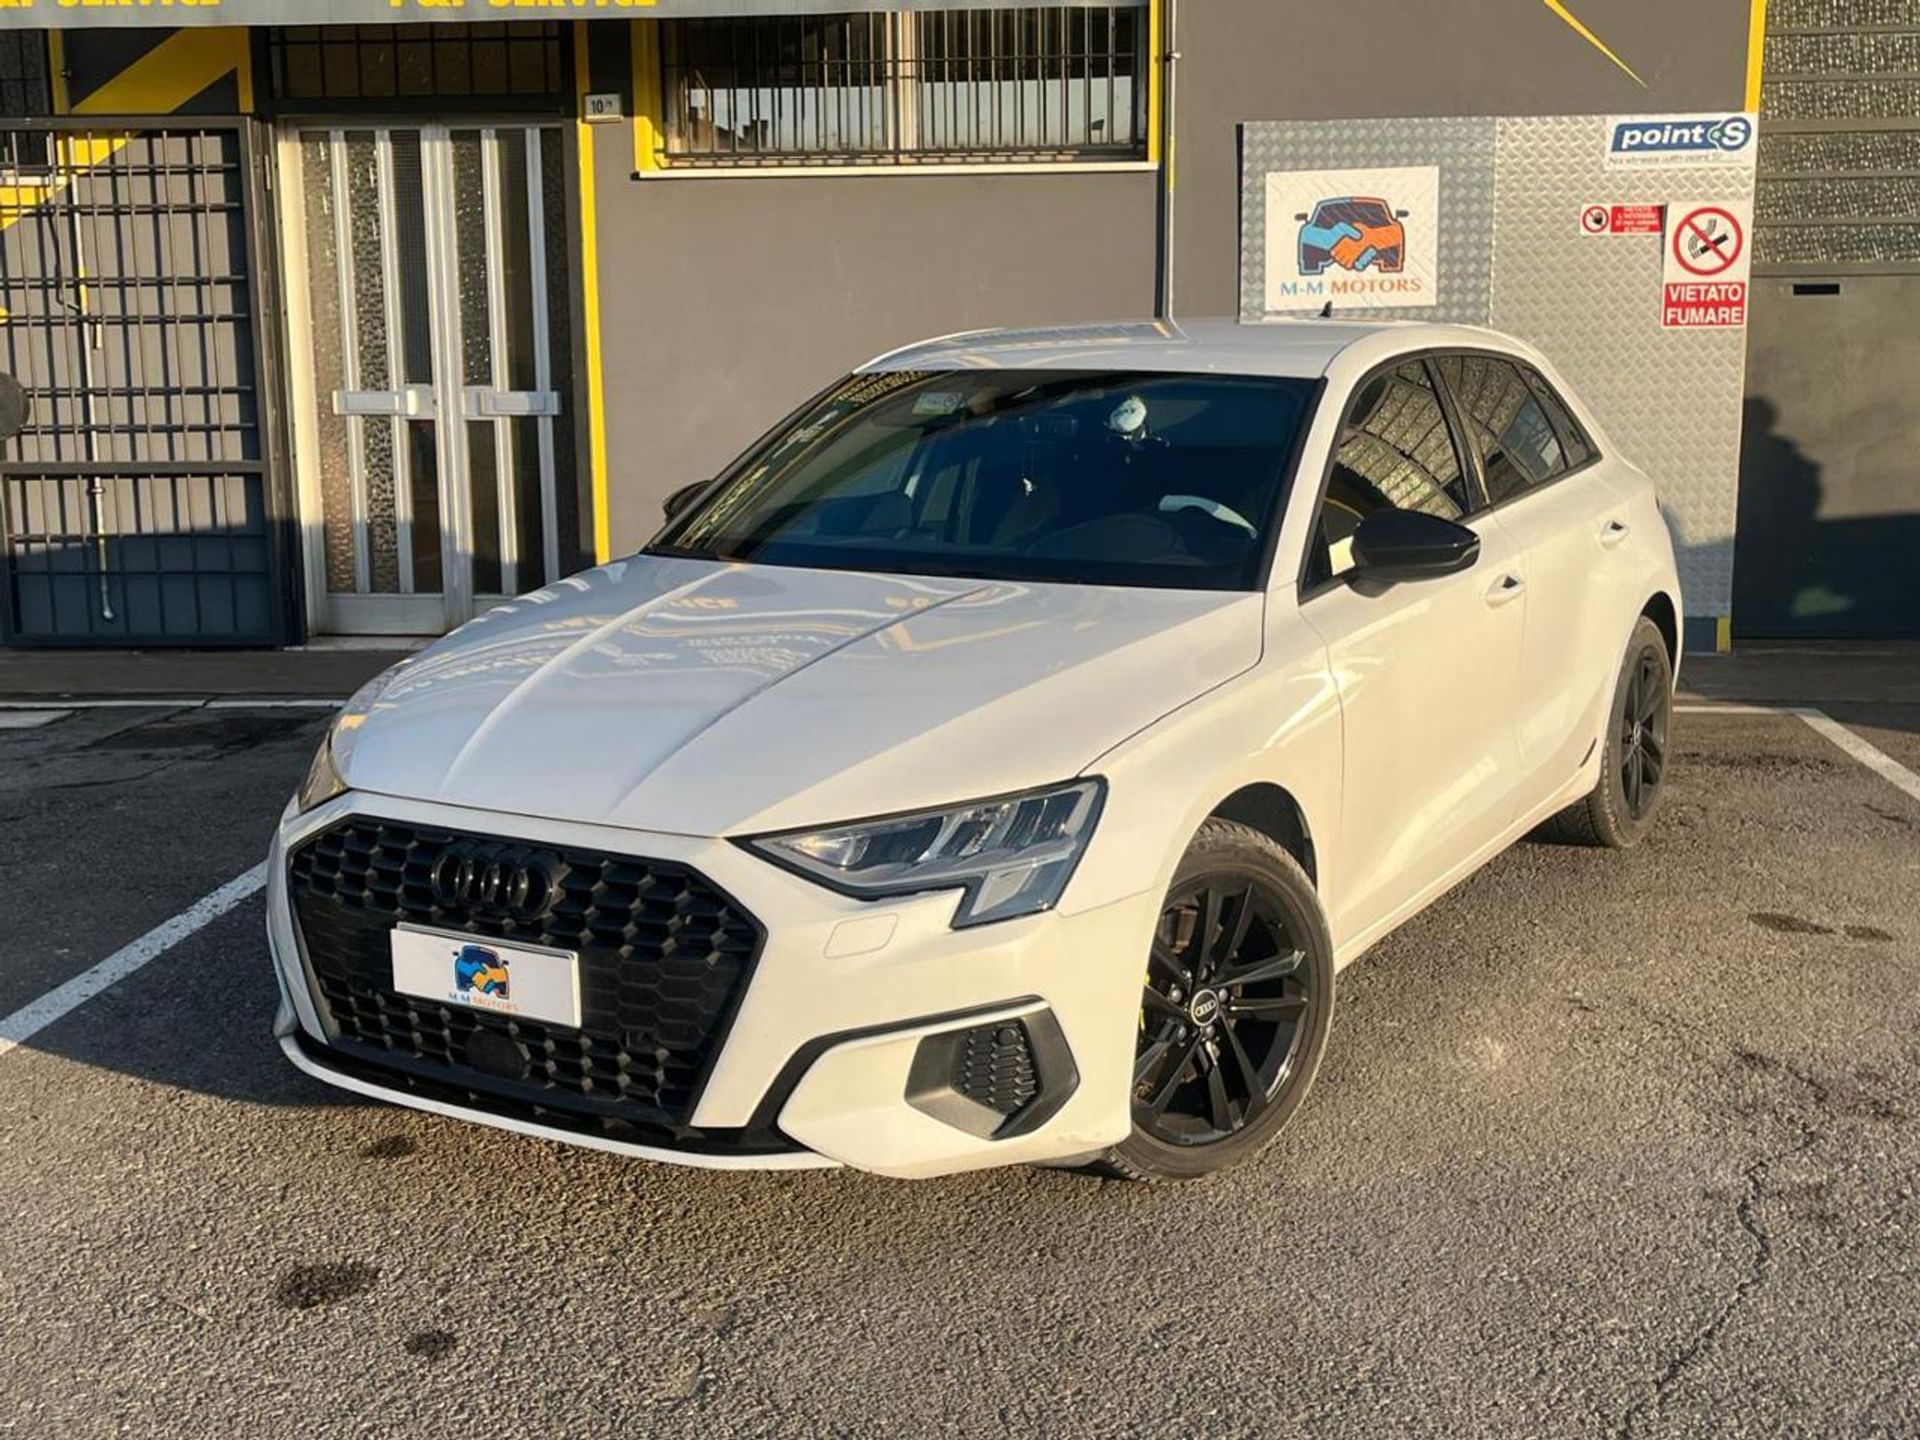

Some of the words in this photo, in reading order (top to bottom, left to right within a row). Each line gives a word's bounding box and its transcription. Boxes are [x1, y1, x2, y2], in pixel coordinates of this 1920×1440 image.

[1621, 124, 1705, 149] point
[1722, 121, 1746, 146] S
[1280, 281, 1323, 296] M-M
[1330, 278, 1422, 295] MOTORS
[1668, 284, 1742, 302] VIETATO
[1666, 307, 1742, 324] FUMARE
